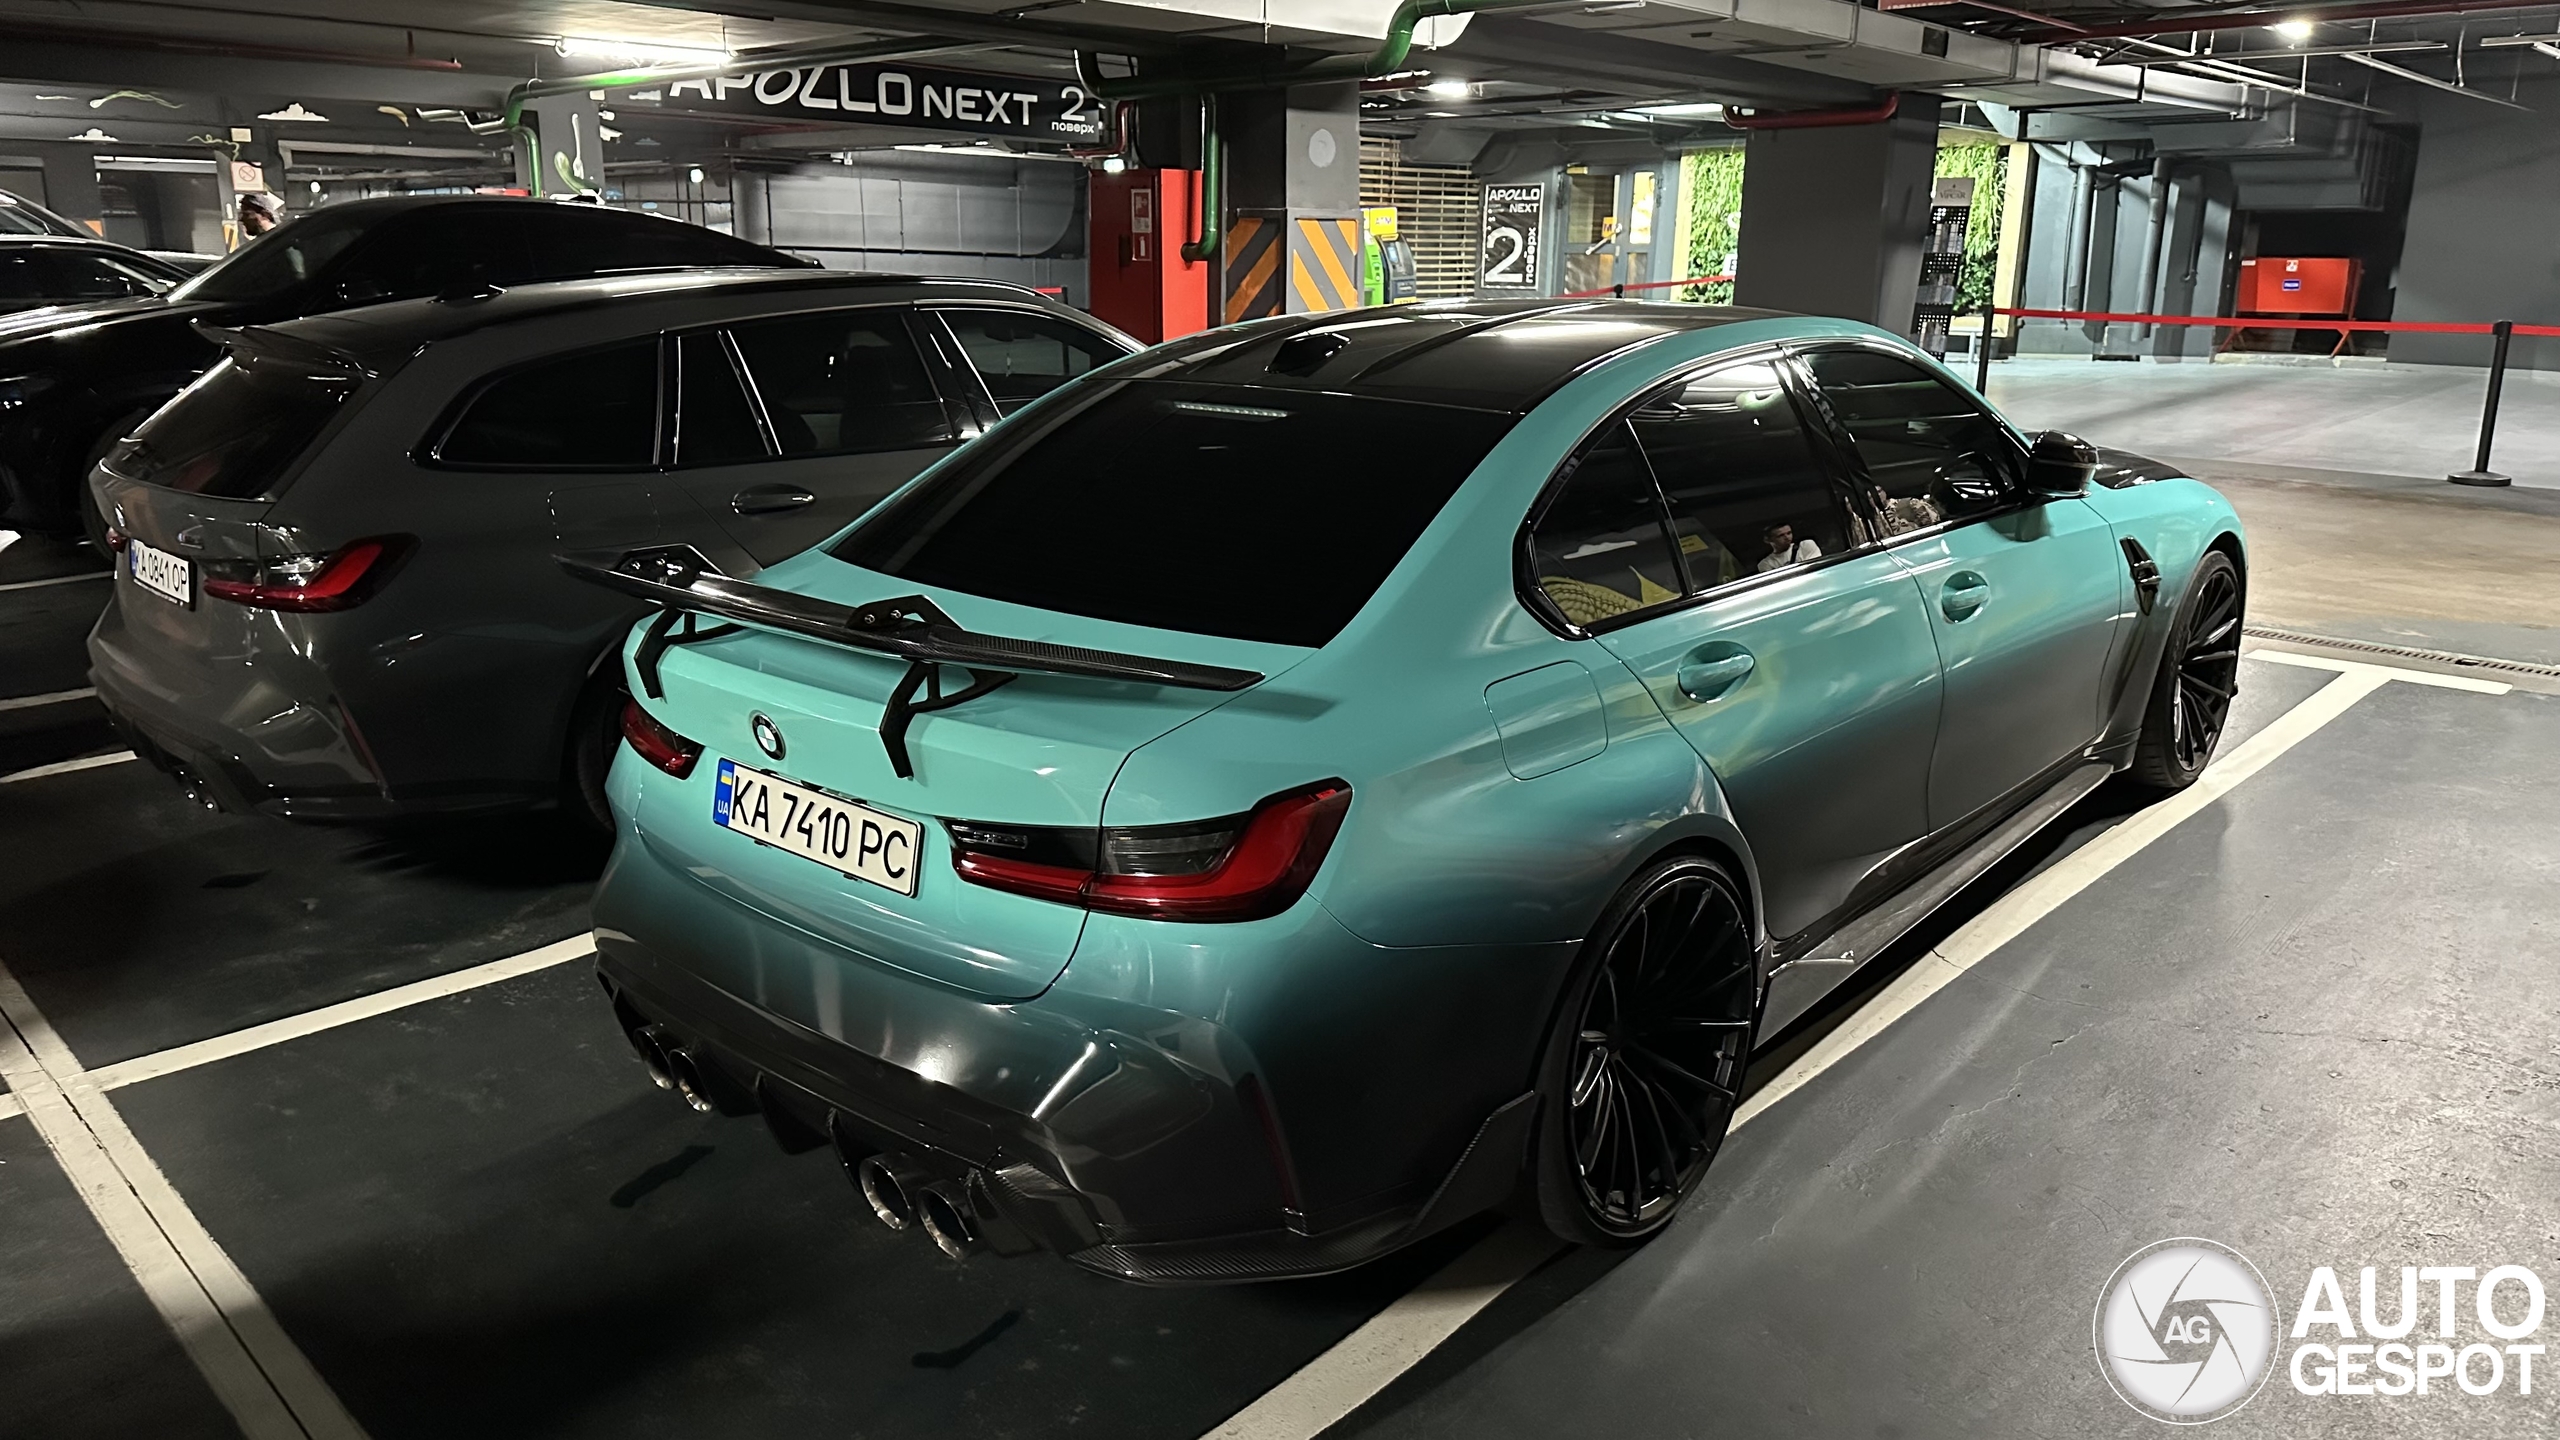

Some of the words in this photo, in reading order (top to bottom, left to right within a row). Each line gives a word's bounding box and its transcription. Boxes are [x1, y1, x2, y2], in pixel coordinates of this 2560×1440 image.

[669, 67, 912, 115] APOLLO
[923, 84, 1038, 126] NEXT
[1061, 86, 1086, 122] 2
[1051, 121, 1095, 135] поверх
[1488, 188, 1540, 201] APOLLO
[1509, 203, 1539, 213] NEXT
[1485, 227, 1523, 283] 2
[1526, 227, 1537, 283] поверх
[148, 551, 171, 589] 0841
[172, 563, 188, 595] OP
[717, 799, 729, 816] UA
[731, 775, 769, 833] KA
[780, 792, 850, 859] 7410
[858, 819, 908, 879] PC
